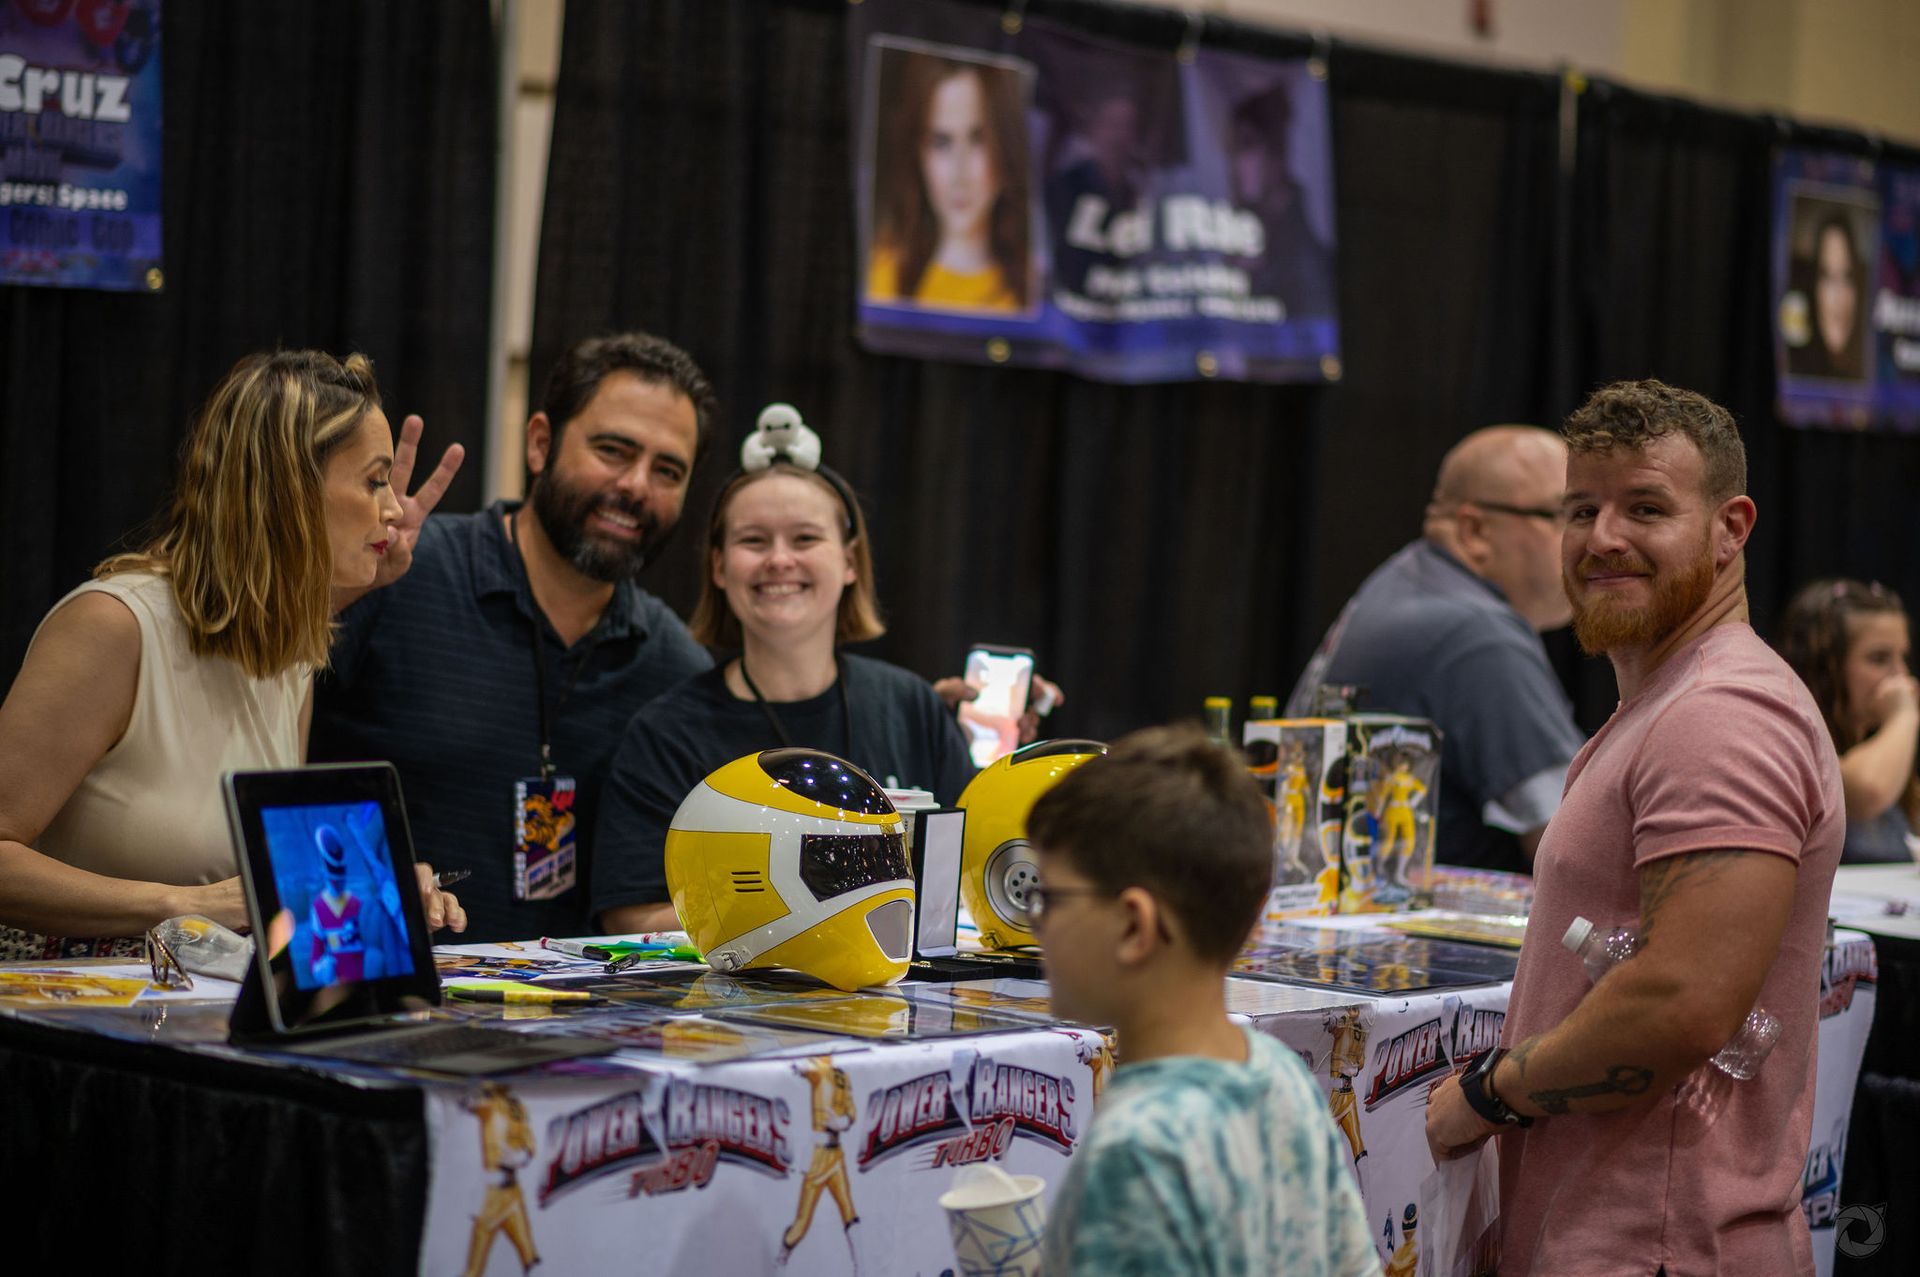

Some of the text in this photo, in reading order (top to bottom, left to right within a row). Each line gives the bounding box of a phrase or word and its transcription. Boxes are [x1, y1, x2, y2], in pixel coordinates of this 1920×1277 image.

[0, 53, 130, 122] Cruz
[58, 183, 127, 211] Space
[1367, 1019, 1440, 1103] POWER
[1454, 1004, 1506, 1058] RANG
[541, 1079, 794, 1198] POWER RANGERS
[859, 1057, 1078, 1163] POWER RANGERS
[931, 1116, 1016, 1168] TURBO
